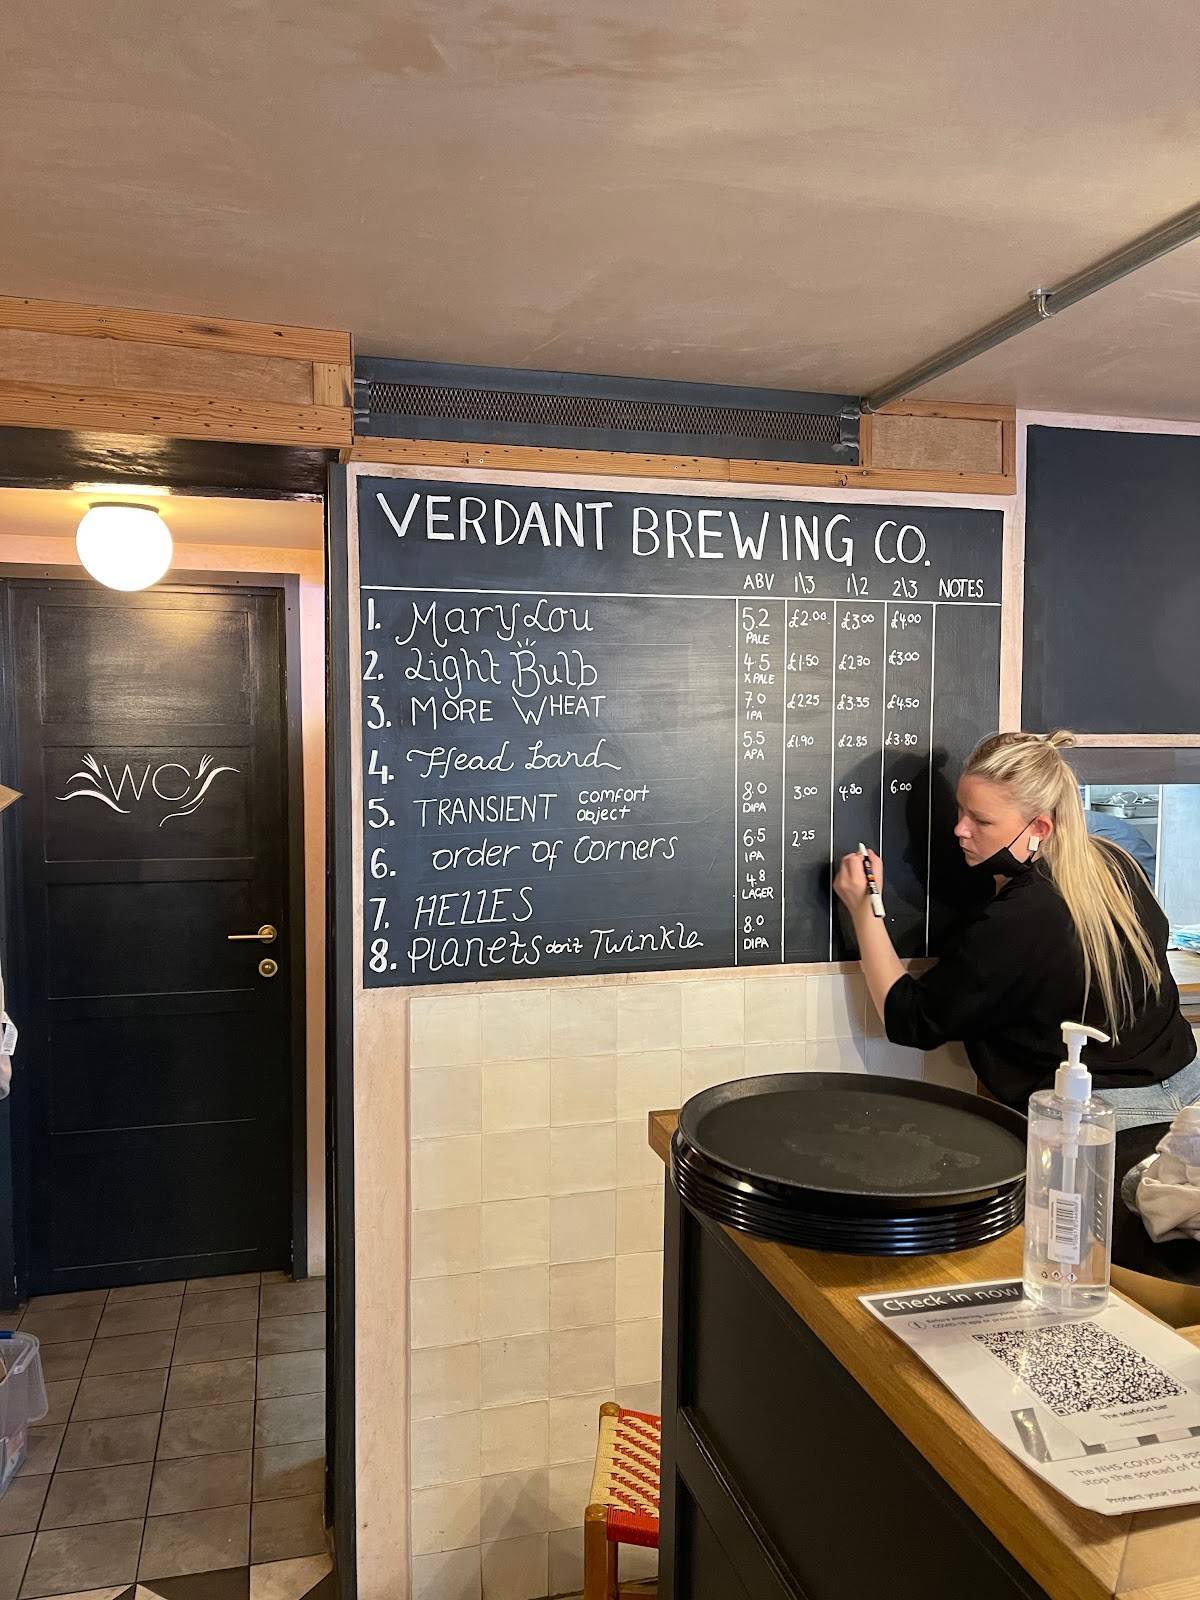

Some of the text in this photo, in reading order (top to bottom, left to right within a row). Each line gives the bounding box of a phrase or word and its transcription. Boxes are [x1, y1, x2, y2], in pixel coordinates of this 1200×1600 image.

[376, 492, 931, 567] VERDANT BREWING CO.
[743, 572, 775, 591] ABV
[938, 578, 984, 598] NOTES
[366, 597, 381, 630] 1.
[788, 610, 827, 629] £2.00
[890, 610, 922, 631] £4.00
[745, 631, 771, 645] PALE
[786, 652, 820, 672] £1.50
[362, 647, 598, 700] 2. Light Bulb
[752, 672, 776, 685] PALE
[366, 694, 606, 730] 3. MORE WHEAT
[746, 710, 763, 721] IPA
[885, 731, 919, 747] £3.80
[367, 749, 395, 785] 4.
[405, 740, 515, 779] Head
[743, 749, 765, 760] APA
[103, 763, 191, 802] WC
[793, 785, 819, 800] 3.00
[890, 779, 913, 794] 6.00
[578, 784, 650, 805] comfort
[367, 793, 558, 829] 5. TRANSIENT
[576, 805, 631, 825] object
[742, 802, 767, 814] DIPA
[742, 828, 767, 847] 6.5
[370, 835, 679, 879] 6. order of Corners
[744, 850, 765, 863] IPA
[741, 886, 775, 900] LAGER
[369, 898, 390, 931] 7.
[368, 938, 398, 973] 8.
[407, 931, 543, 974] Planets
[590, 922, 704, 960] Twinkle
[743, 937, 770, 950] DIPA
[883, 1285, 1020, 1312] Check in now
[1068, 1467, 1096, 1478] The
[1094, 1462, 1123, 1474] NHS
[1123, 1452, 1181, 1470] COVID-19
[1081, 1476, 1111, 1487] stop
[1110, 1472, 1134, 1482] the
[1134, 1465, 1176, 1480] spread
[1176, 1462, 1191, 1473] of
